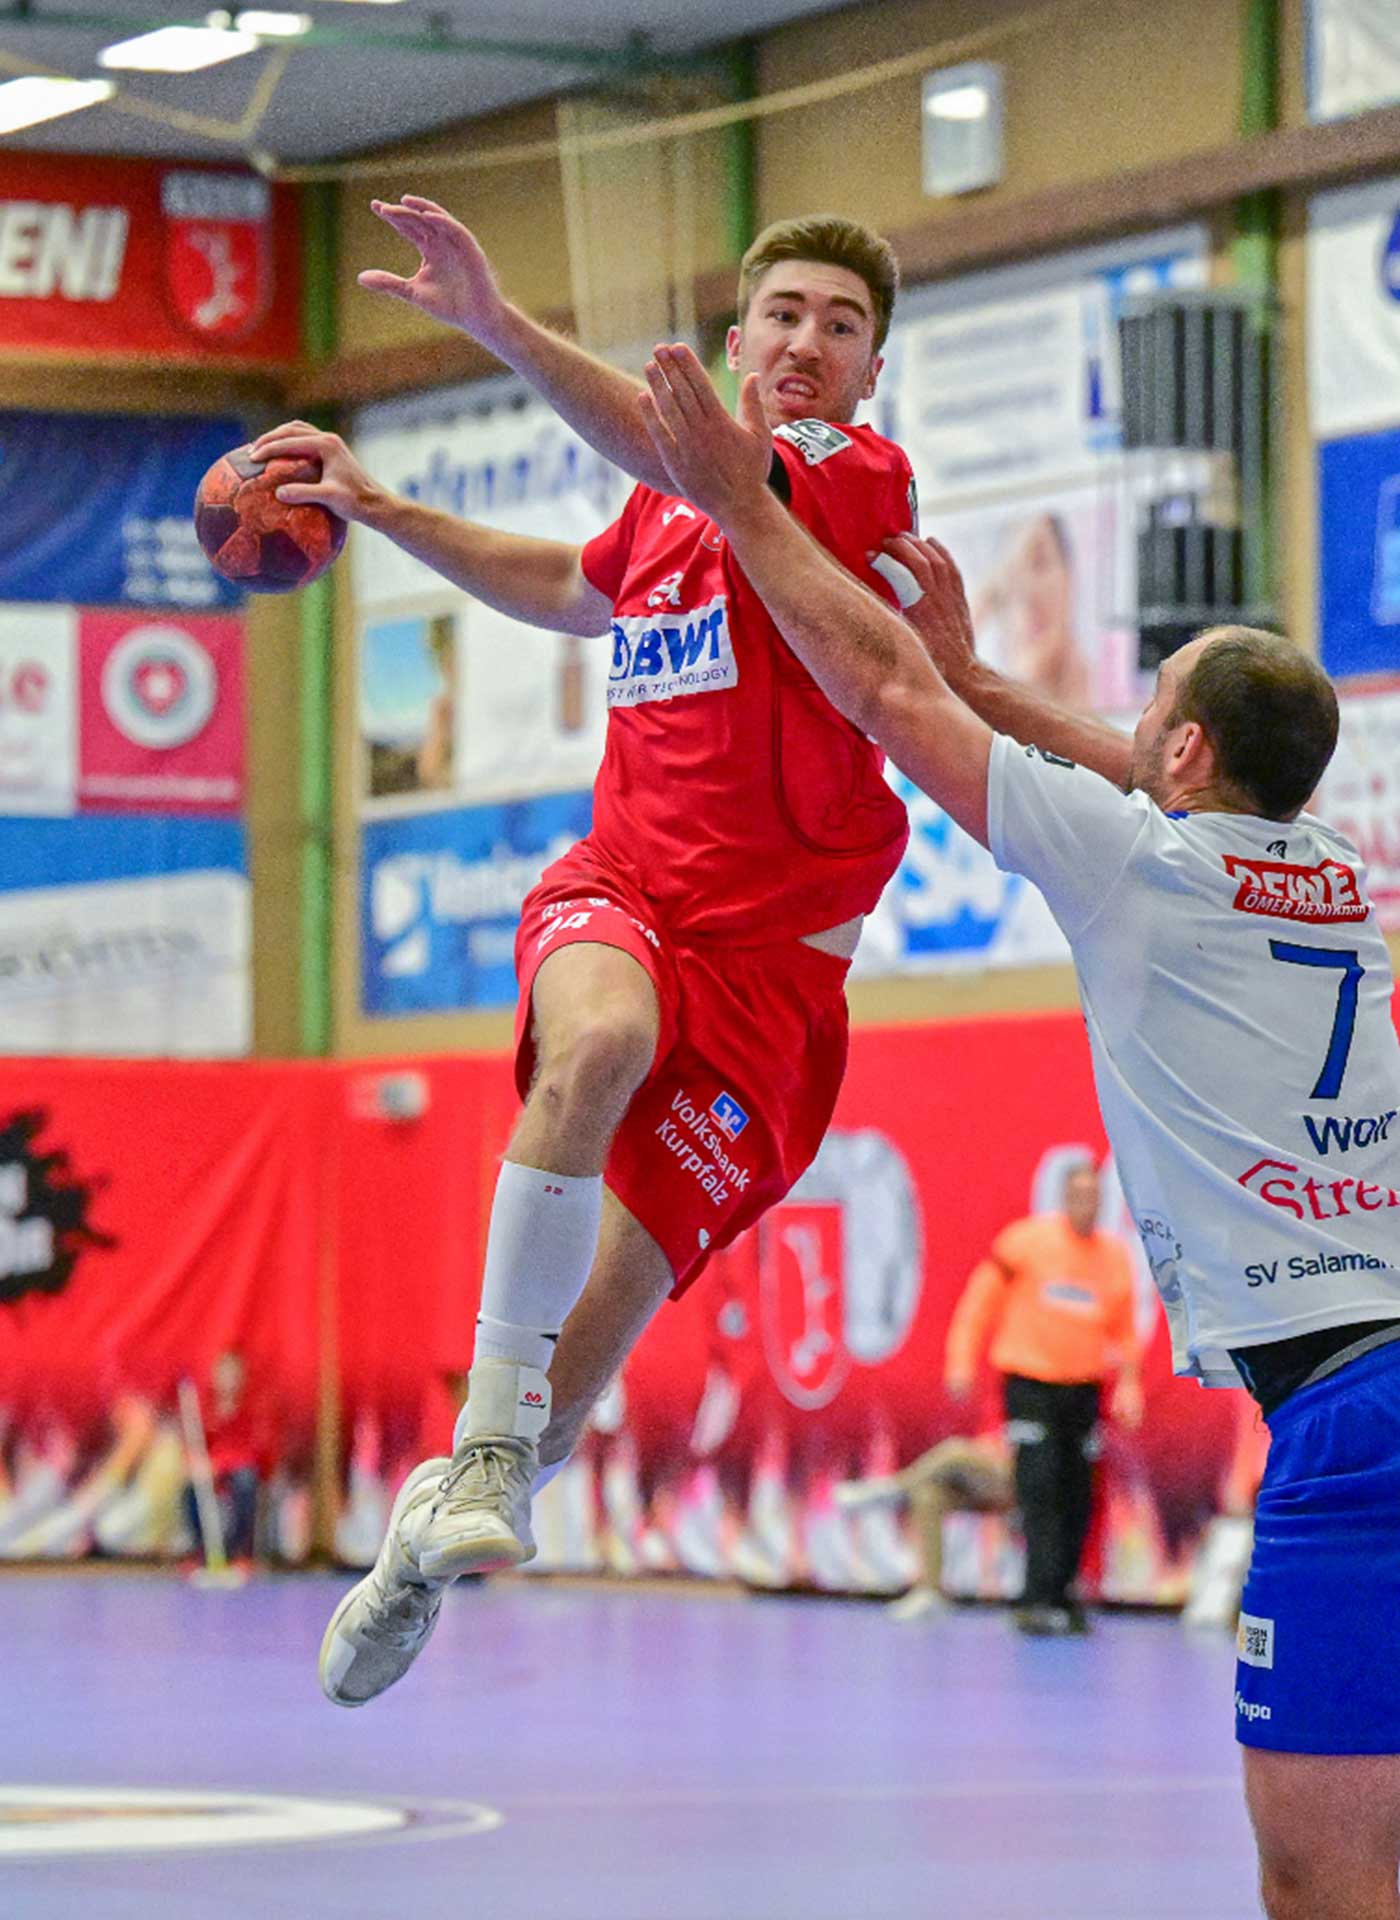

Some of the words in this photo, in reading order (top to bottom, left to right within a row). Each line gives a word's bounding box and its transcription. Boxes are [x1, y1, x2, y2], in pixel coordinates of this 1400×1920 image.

[630, 607, 724, 677] BWT
[1243, 889, 1294, 914] ÖMER
[1268, 938, 1366, 1100] 7
[655, 1118, 730, 1206] Kurpfalz
[671, 1089, 751, 1193] Volksbank
[1245, 1261, 1278, 1287] SV
